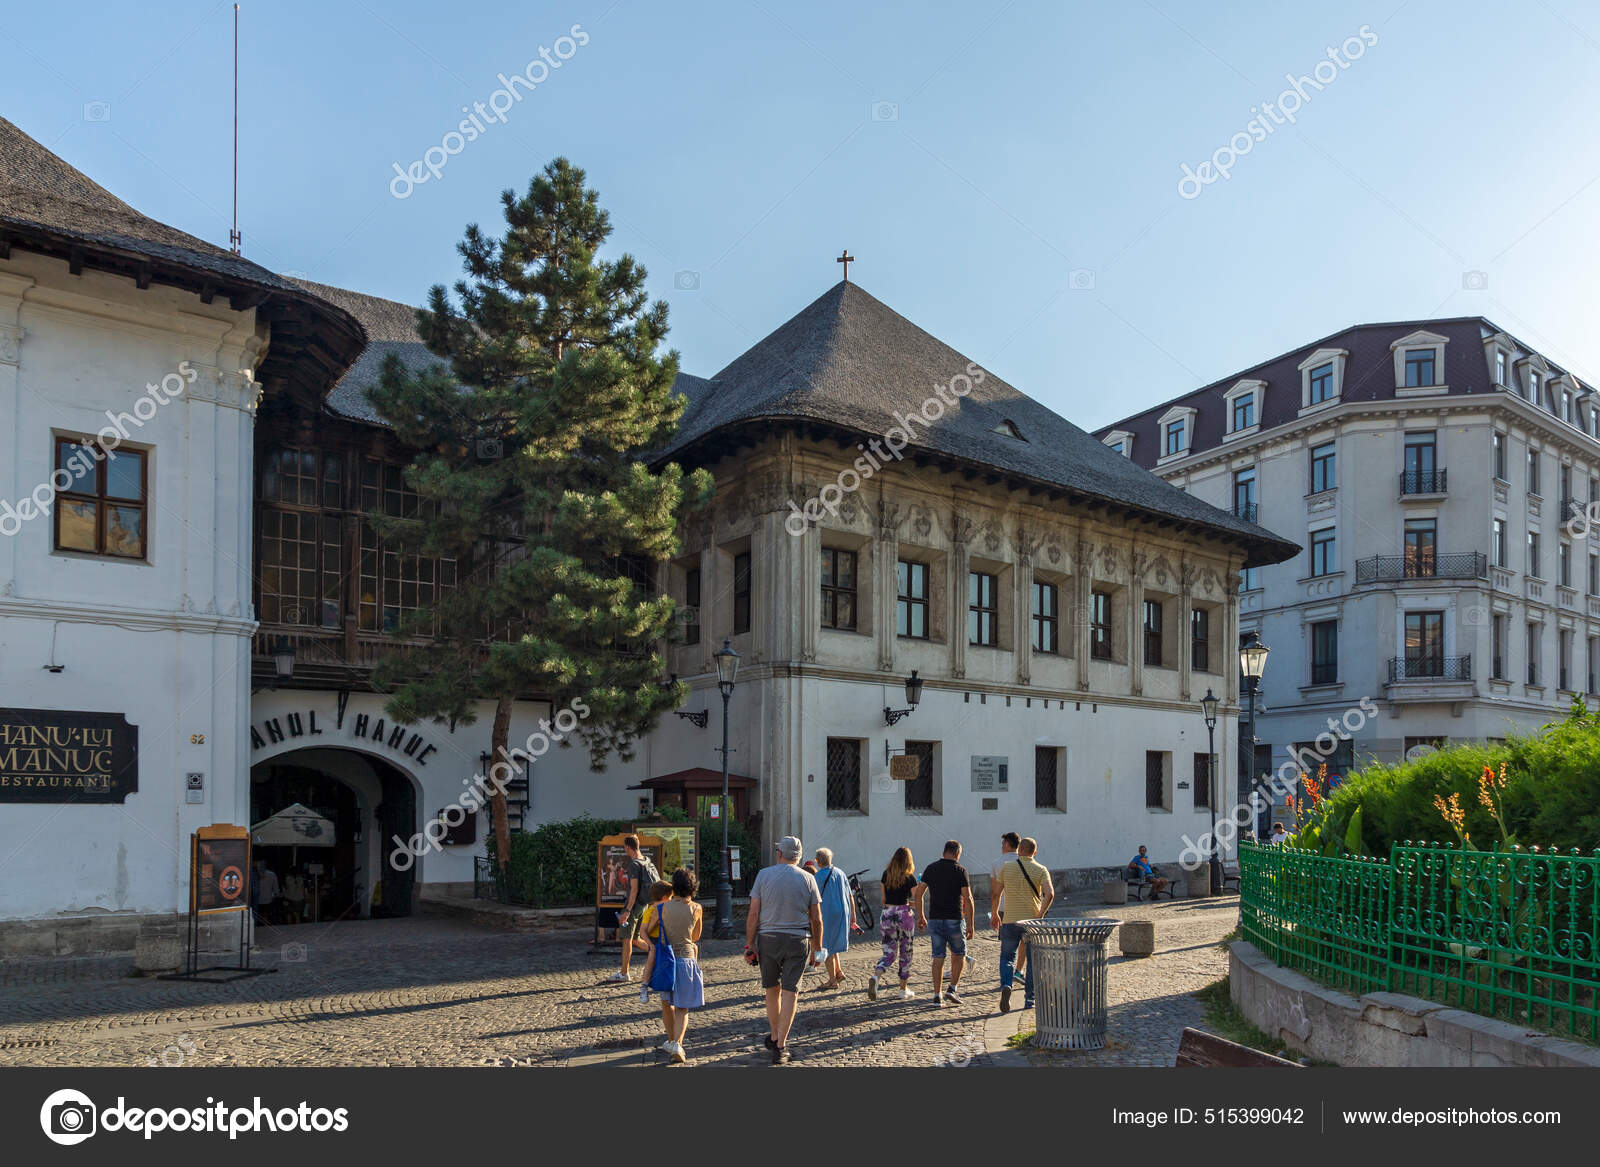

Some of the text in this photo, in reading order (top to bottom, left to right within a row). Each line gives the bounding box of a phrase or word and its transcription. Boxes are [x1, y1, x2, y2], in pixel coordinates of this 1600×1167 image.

[251, 710, 322, 750] ANUL
[190, 734, 205, 744] 62
[0, 774, 112, 788] ESTAURANT
